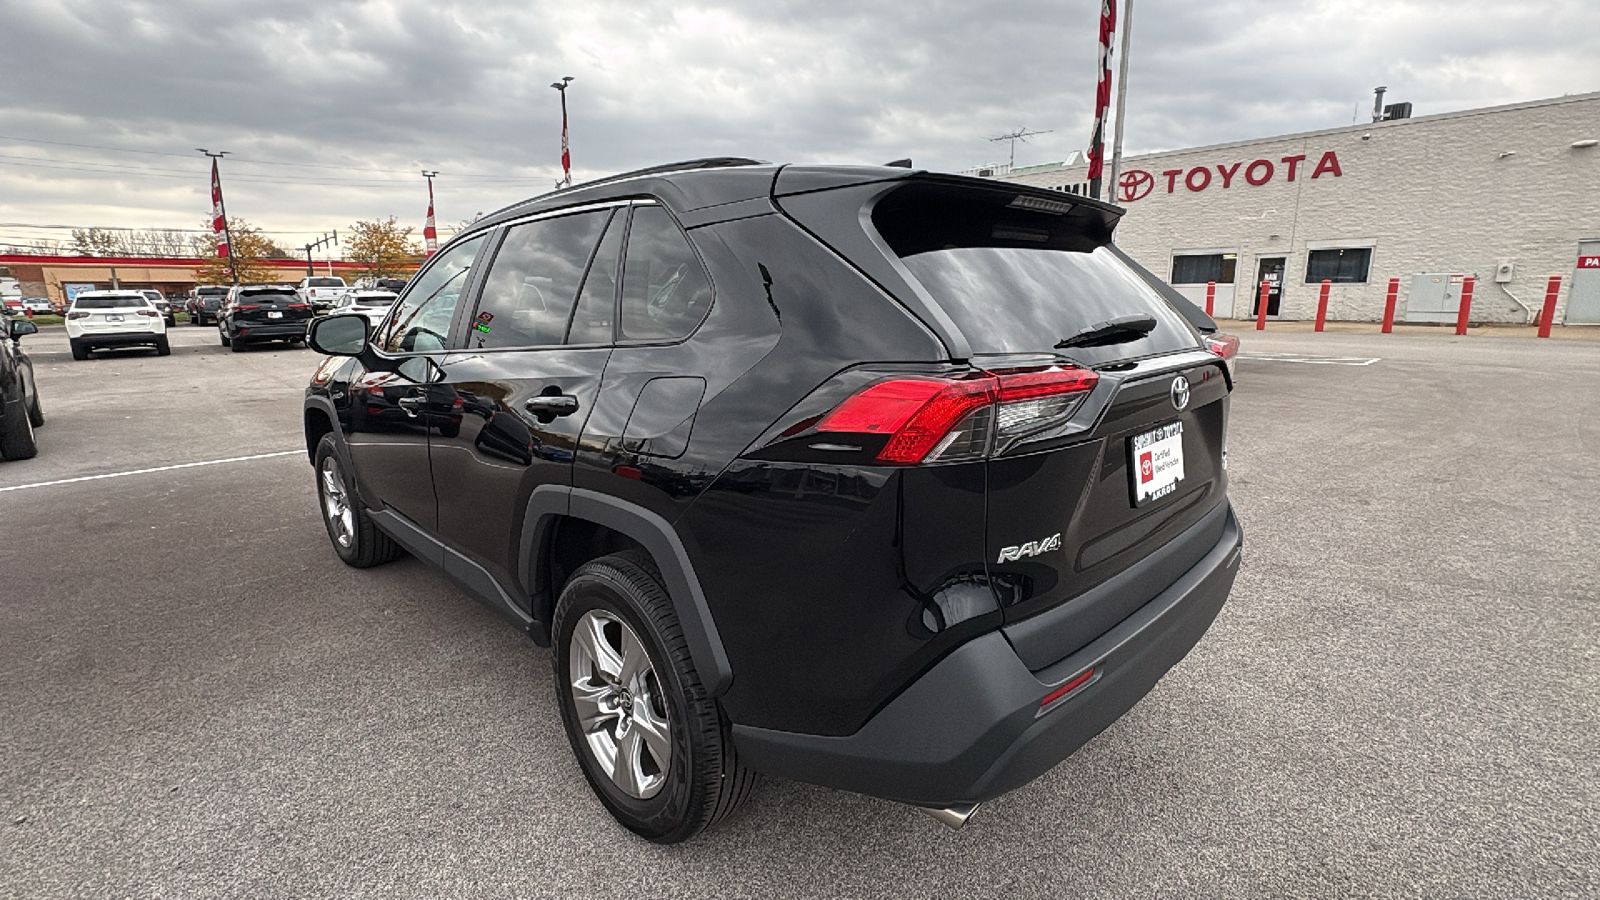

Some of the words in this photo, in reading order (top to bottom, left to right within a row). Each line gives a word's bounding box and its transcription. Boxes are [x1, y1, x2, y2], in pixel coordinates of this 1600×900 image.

[1162, 151, 1342, 194] TOYOTA
[1151, 483, 1176, 501] AKRON
[996, 532, 1062, 564] RAV4
